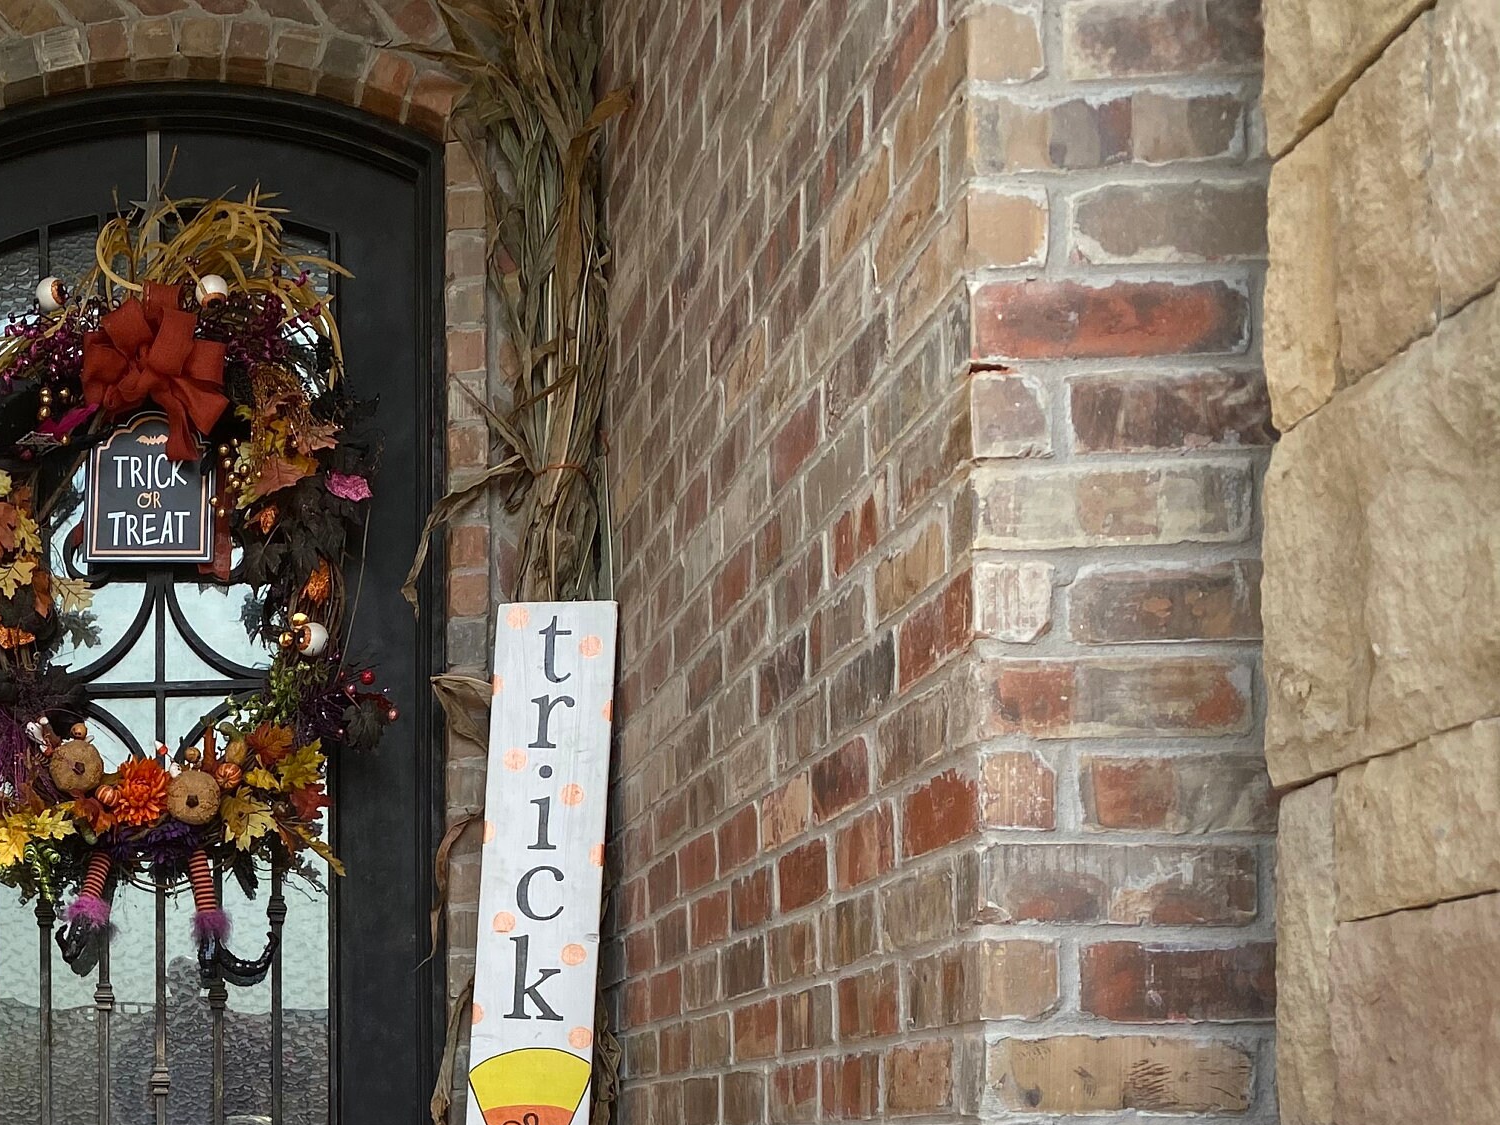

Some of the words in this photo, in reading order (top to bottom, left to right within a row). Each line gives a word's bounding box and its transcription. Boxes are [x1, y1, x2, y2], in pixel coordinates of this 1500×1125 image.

[112, 453, 188, 489] TRICK
[136, 490, 162, 509] OR
[107, 511, 191, 546] TREAT
[502, 615, 575, 1022] trick
